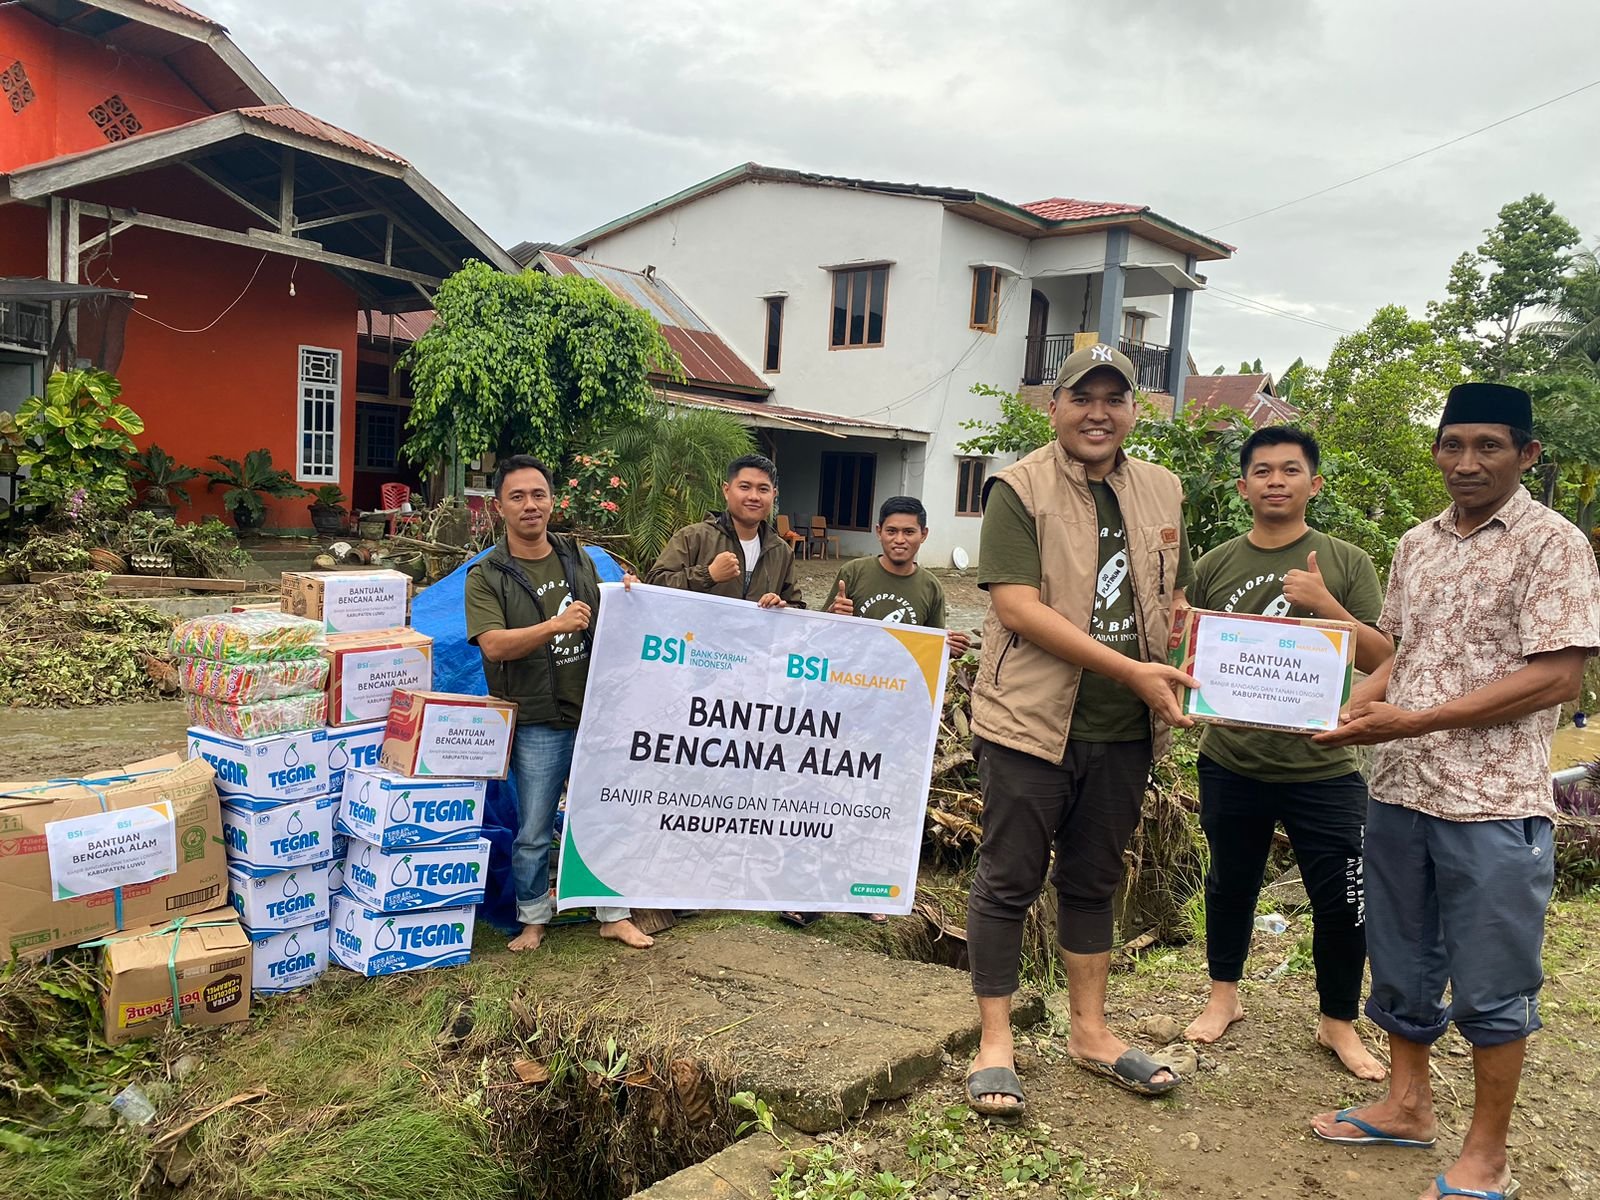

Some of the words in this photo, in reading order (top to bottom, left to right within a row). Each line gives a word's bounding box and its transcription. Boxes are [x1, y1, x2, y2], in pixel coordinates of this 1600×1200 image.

[1091, 345, 1112, 361] NY
[338, 596, 373, 604] BENCANA
[375, 594, 394, 602] ALAM
[350, 587, 384, 595] BANTUAN
[1224, 573, 1274, 612] BELOPA
[860, 594, 895, 614] BELOPA
[1220, 632, 1238, 642] BSI
[1278, 638, 1296, 648] BSI
[641, 634, 686, 664] BSI
[690, 649, 713, 660] BANK
[714, 652, 748, 663] SYARIAH
[690, 658, 732, 670] INDONESIA
[1239, 652, 1302, 669] BANTUAN
[370, 670, 407, 680] BANTUAN
[787, 654, 828, 682] BSI
[830, 671, 907, 692] MASLAHAT
[1220, 664, 1280, 680] BENCANA
[1285, 671, 1320, 684] ALAM
[358, 682, 396, 690] BENCANA
[398, 676, 418, 686] ALAM
[1230, 682, 1260, 691] BANDANG
[1274, 687, 1294, 696] TANAH
[1232, 690, 1276, 702] KABUPATEN
[1278, 695, 1300, 704] LUWU
[688, 696, 842, 740] BANTUAN
[436, 737, 472, 746] BENCANA
[448, 728, 486, 737] BANTUAN
[629, 730, 786, 772] BENCANA
[798, 746, 882, 780] ALAM
[268, 764, 316, 788] TEGAR
[348, 800, 376, 824] TEGAR
[412, 798, 476, 824] TEGAR
[600, 788, 653, 806] BANJIR
[657, 792, 733, 810] BANDANG
[737, 796, 768, 811] DAN
[772, 798, 820, 815] TANAH
[823, 801, 891, 820] LONGSOR
[117, 820, 132, 829] BSI
[660, 814, 774, 836] KABUPATEN
[778, 820, 834, 838] LUWU
[68, 830, 82, 840] BSI
[88, 832, 140, 850] BANTUAN
[224, 822, 248, 854] GAR
[270, 830, 320, 856] TEGAR
[72, 847, 126, 864] BENCANA
[129, 838, 157, 852] ALAM
[88, 865, 126, 877] KABUPATEN
[127, 861, 146, 870] LUWU
[352, 864, 376, 889] TEGAR
[414, 862, 480, 886] TEGAR
[266, 892, 316, 918] TEGAR
[52, 928, 60, 940] 1
[336, 928, 362, 953] TEGAR
[398, 922, 464, 950] TEGAR
[268, 952, 316, 978] TEGAR
[206, 981, 236, 994] CARAMEL
[206, 986, 240, 1002] CHOCOLATE
[212, 996, 234, 1008] EXTRA
